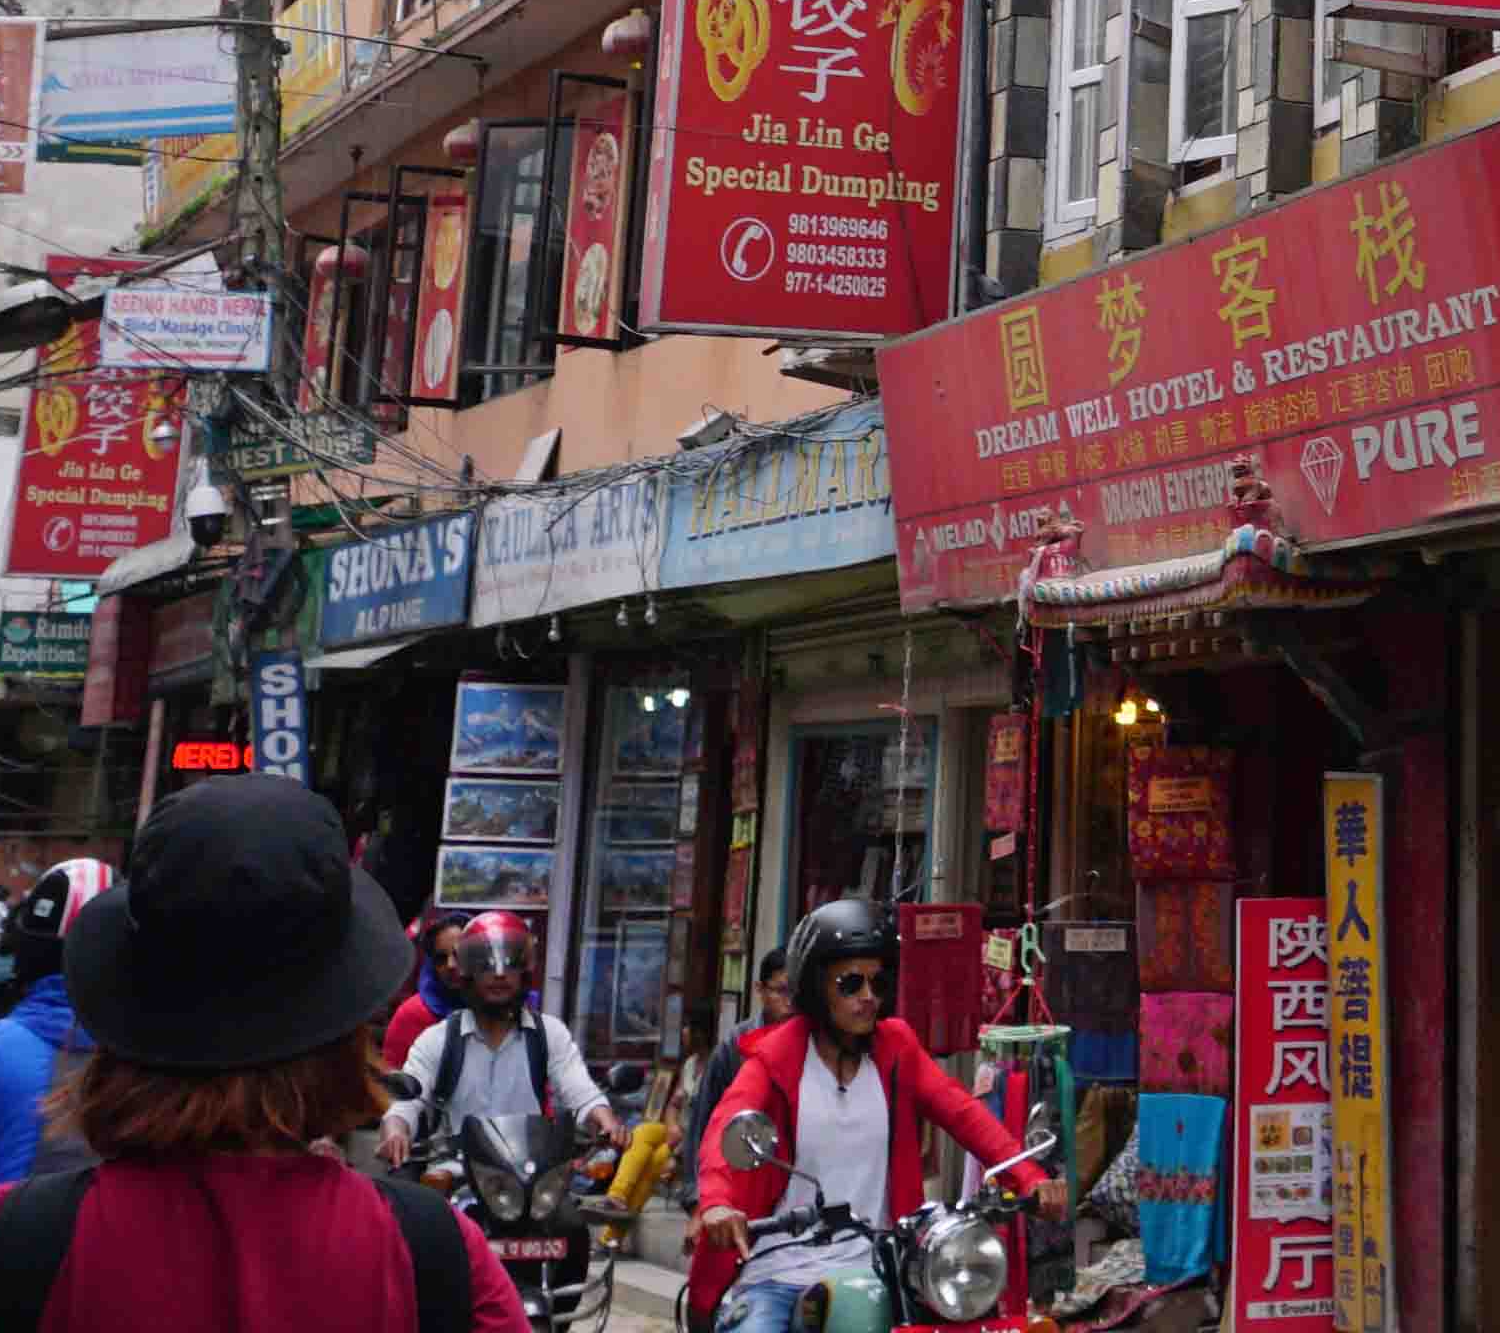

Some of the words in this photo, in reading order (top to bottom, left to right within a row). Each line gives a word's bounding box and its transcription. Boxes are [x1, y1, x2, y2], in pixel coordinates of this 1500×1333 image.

[742, 114, 788, 146] Jia
[797, 118, 843, 150] Lin
[852, 122, 890, 154] Ge
[685, 157, 791, 196] Special
[802, 165, 941, 212] Dumpling
[786, 242, 887, 270] 9803458333
[112, 293, 164, 314] SEEING
[171, 296, 219, 316] HANDS
[998, 179, 1429, 416] 圆梦客栈
[976, 413, 1060, 461] DREAM
[1066, 395, 1120, 439] WELL
[1128, 367, 1224, 423] HOTEL
[1232, 359, 1256, 397] &
[1352, 401, 1488, 481] PURE
[57, 461, 85, 479] Jia
[89, 462, 115, 479] Lin
[119, 464, 143, 482] Ge
[26, 485, 86, 505] Special
[88, 487, 168, 511] Dumpling
[329, 514, 471, 604] SHONA'S
[354, 597, 423, 639] ALPINE
